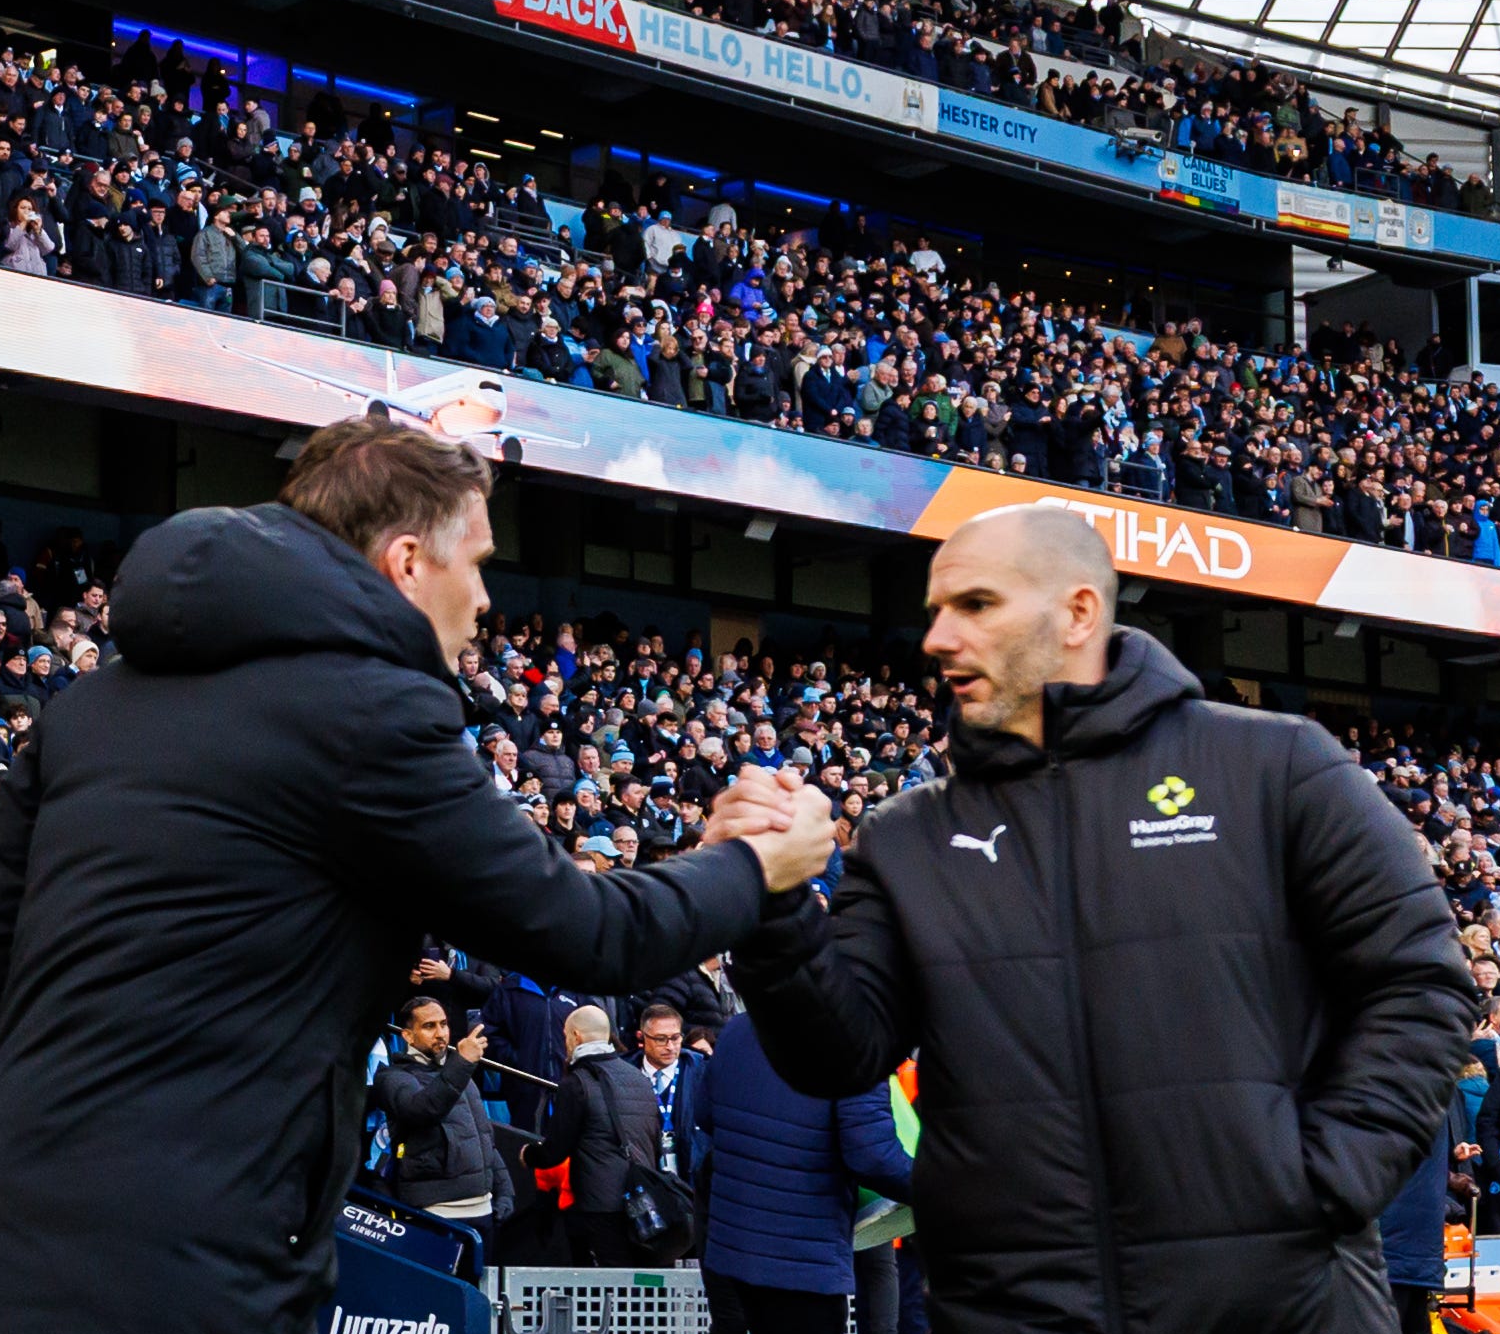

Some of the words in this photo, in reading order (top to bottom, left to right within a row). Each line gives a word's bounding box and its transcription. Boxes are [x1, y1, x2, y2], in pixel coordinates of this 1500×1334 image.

[639, 9, 752, 78] HELLO,
[764, 45, 872, 103] HELLO.
[938, 101, 999, 135] HESTER
[1003, 120, 1037, 144] CITY
[1191, 172, 1227, 193] BLUES
[1033, 496, 1252, 580] TIHAD
[342, 1205, 406, 1237] ETIHAD
[349, 1223, 387, 1243] AIRWAYS
